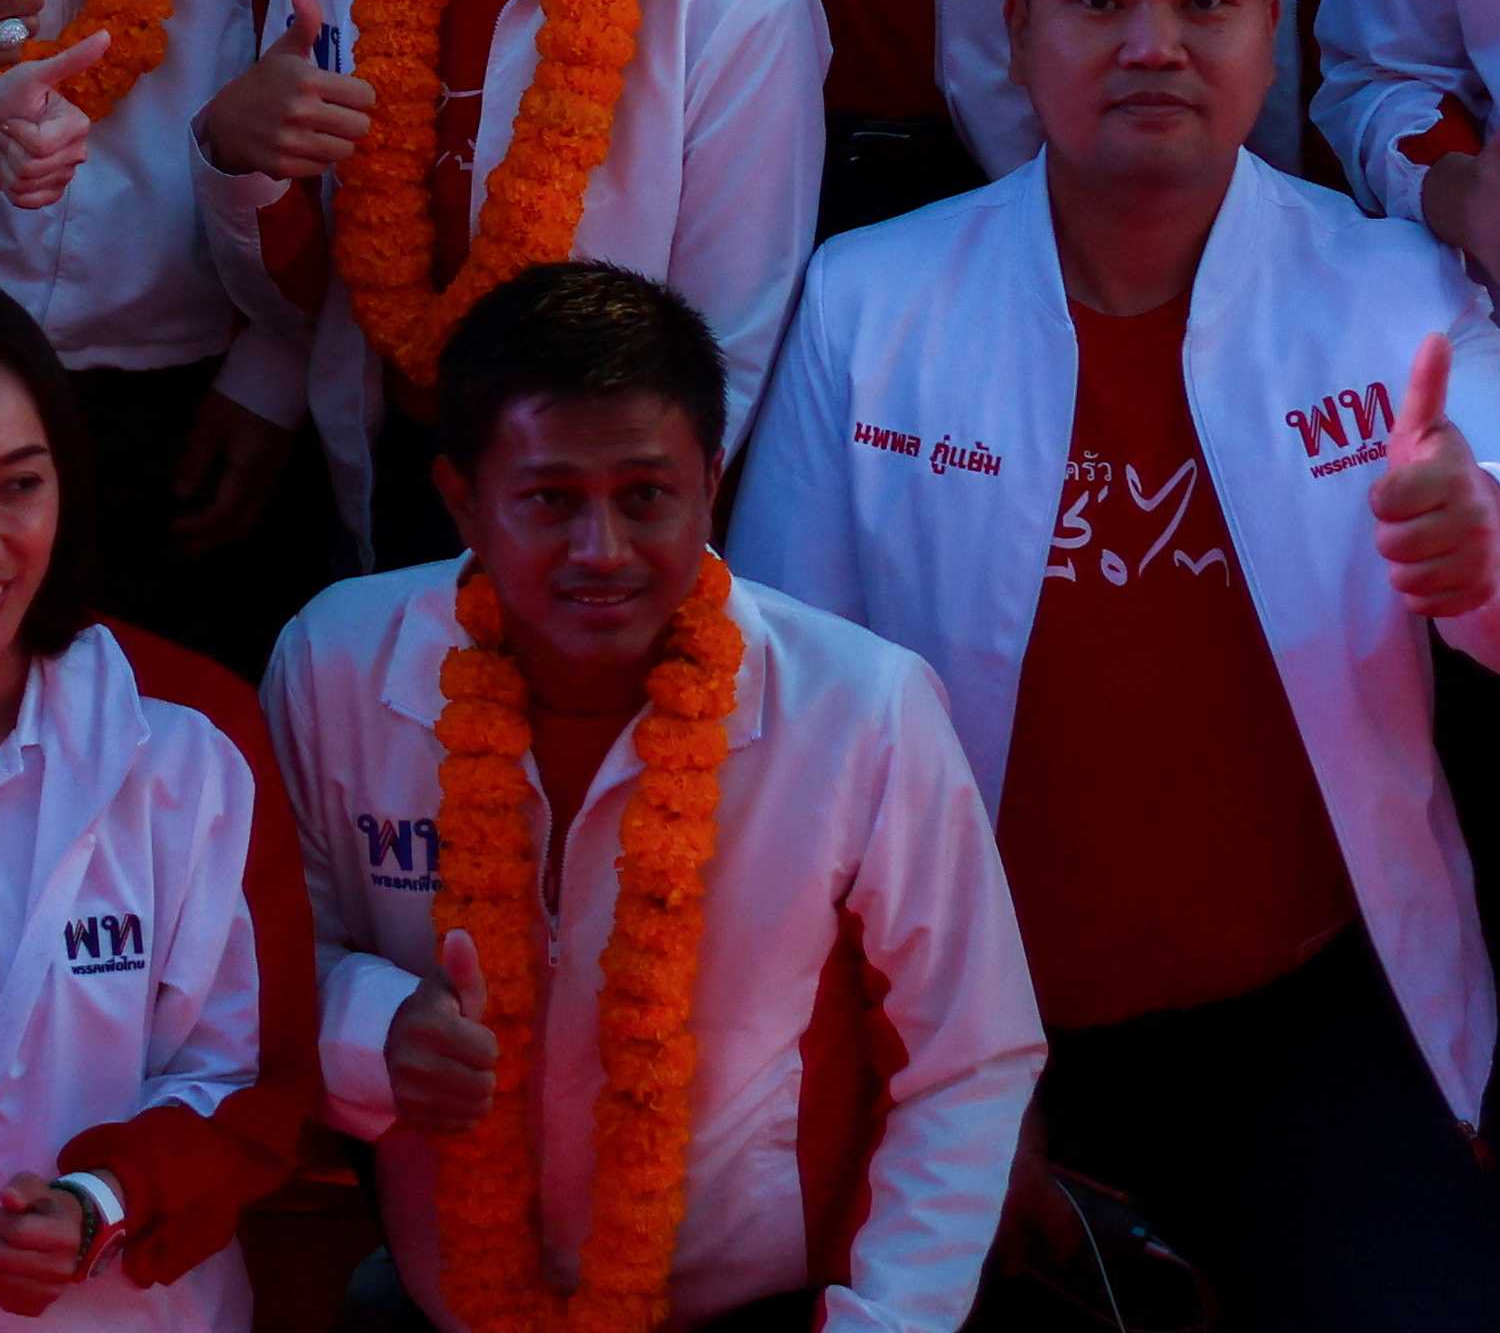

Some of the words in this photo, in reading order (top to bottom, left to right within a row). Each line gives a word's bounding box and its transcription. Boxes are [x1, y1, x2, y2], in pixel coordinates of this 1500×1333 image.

[1285, 381, 1395, 458] พท
[854, 421, 921, 457] นพพล
[1310, 441, 1388, 479] พรรคเพื่อไ
[64, 913, 144, 960] พท
[71, 955, 145, 975] พรรคเพื่อไทย
